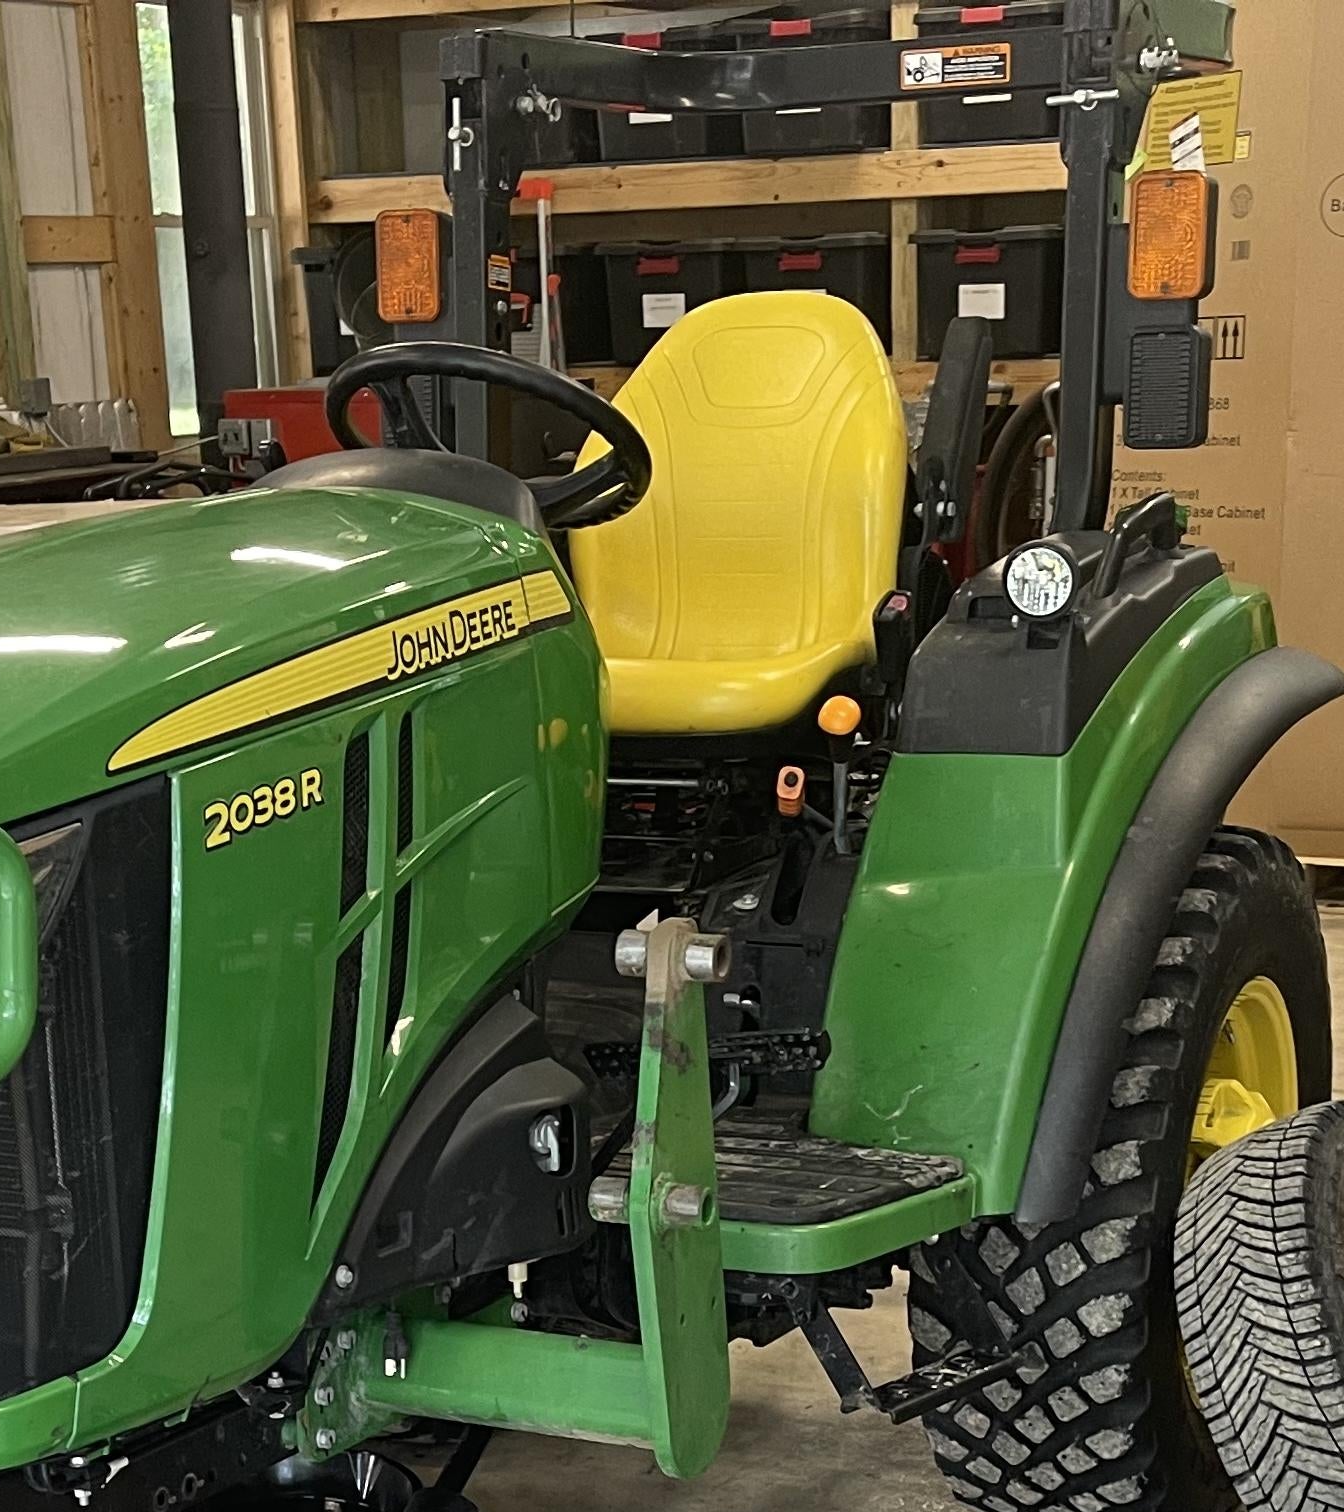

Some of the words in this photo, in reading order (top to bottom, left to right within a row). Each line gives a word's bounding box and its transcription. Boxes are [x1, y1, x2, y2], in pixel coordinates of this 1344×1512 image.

[1120, 487, 1129, 499] X
[1217, 505, 1265, 520] Cabinet
[387, 620, 452, 680] JOHN
[448, 599, 519, 658] DEERE
[204, 777, 297, 849] 2038
[302, 768, 324, 807] R
